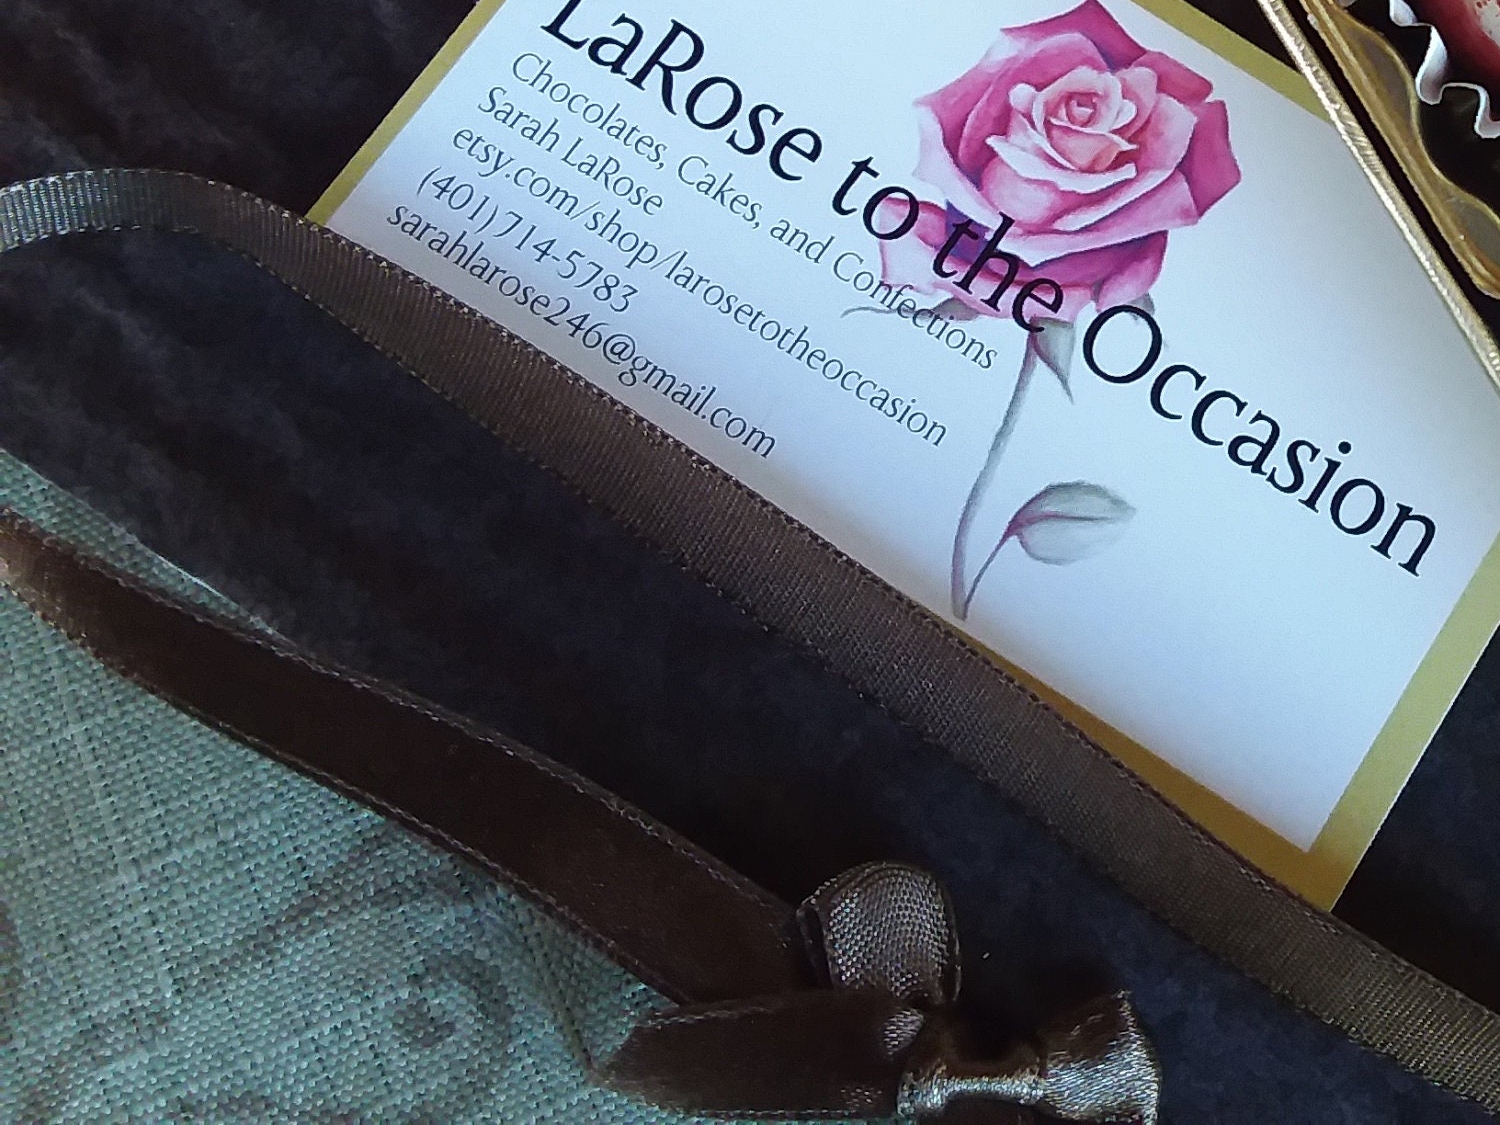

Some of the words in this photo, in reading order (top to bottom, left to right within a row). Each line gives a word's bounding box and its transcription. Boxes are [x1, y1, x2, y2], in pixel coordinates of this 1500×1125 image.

[452, 125, 948, 447] etsy.com/shop/larosetotheoccasion
[478, 86, 560, 154] Sarah
[560, 137, 664, 216] LaRose
[511, 52, 666, 170] Chocolates,
[677, 155, 763, 229] Cakes,
[770, 217, 836, 265] and
[833, 251, 998, 371] Confections
[387, 203, 777, 459] sarahlarose246@gmail.com
[831, 155, 920, 241] to
[932, 211, 1063, 333] the
[1082, 304, 1438, 577] Occasion
